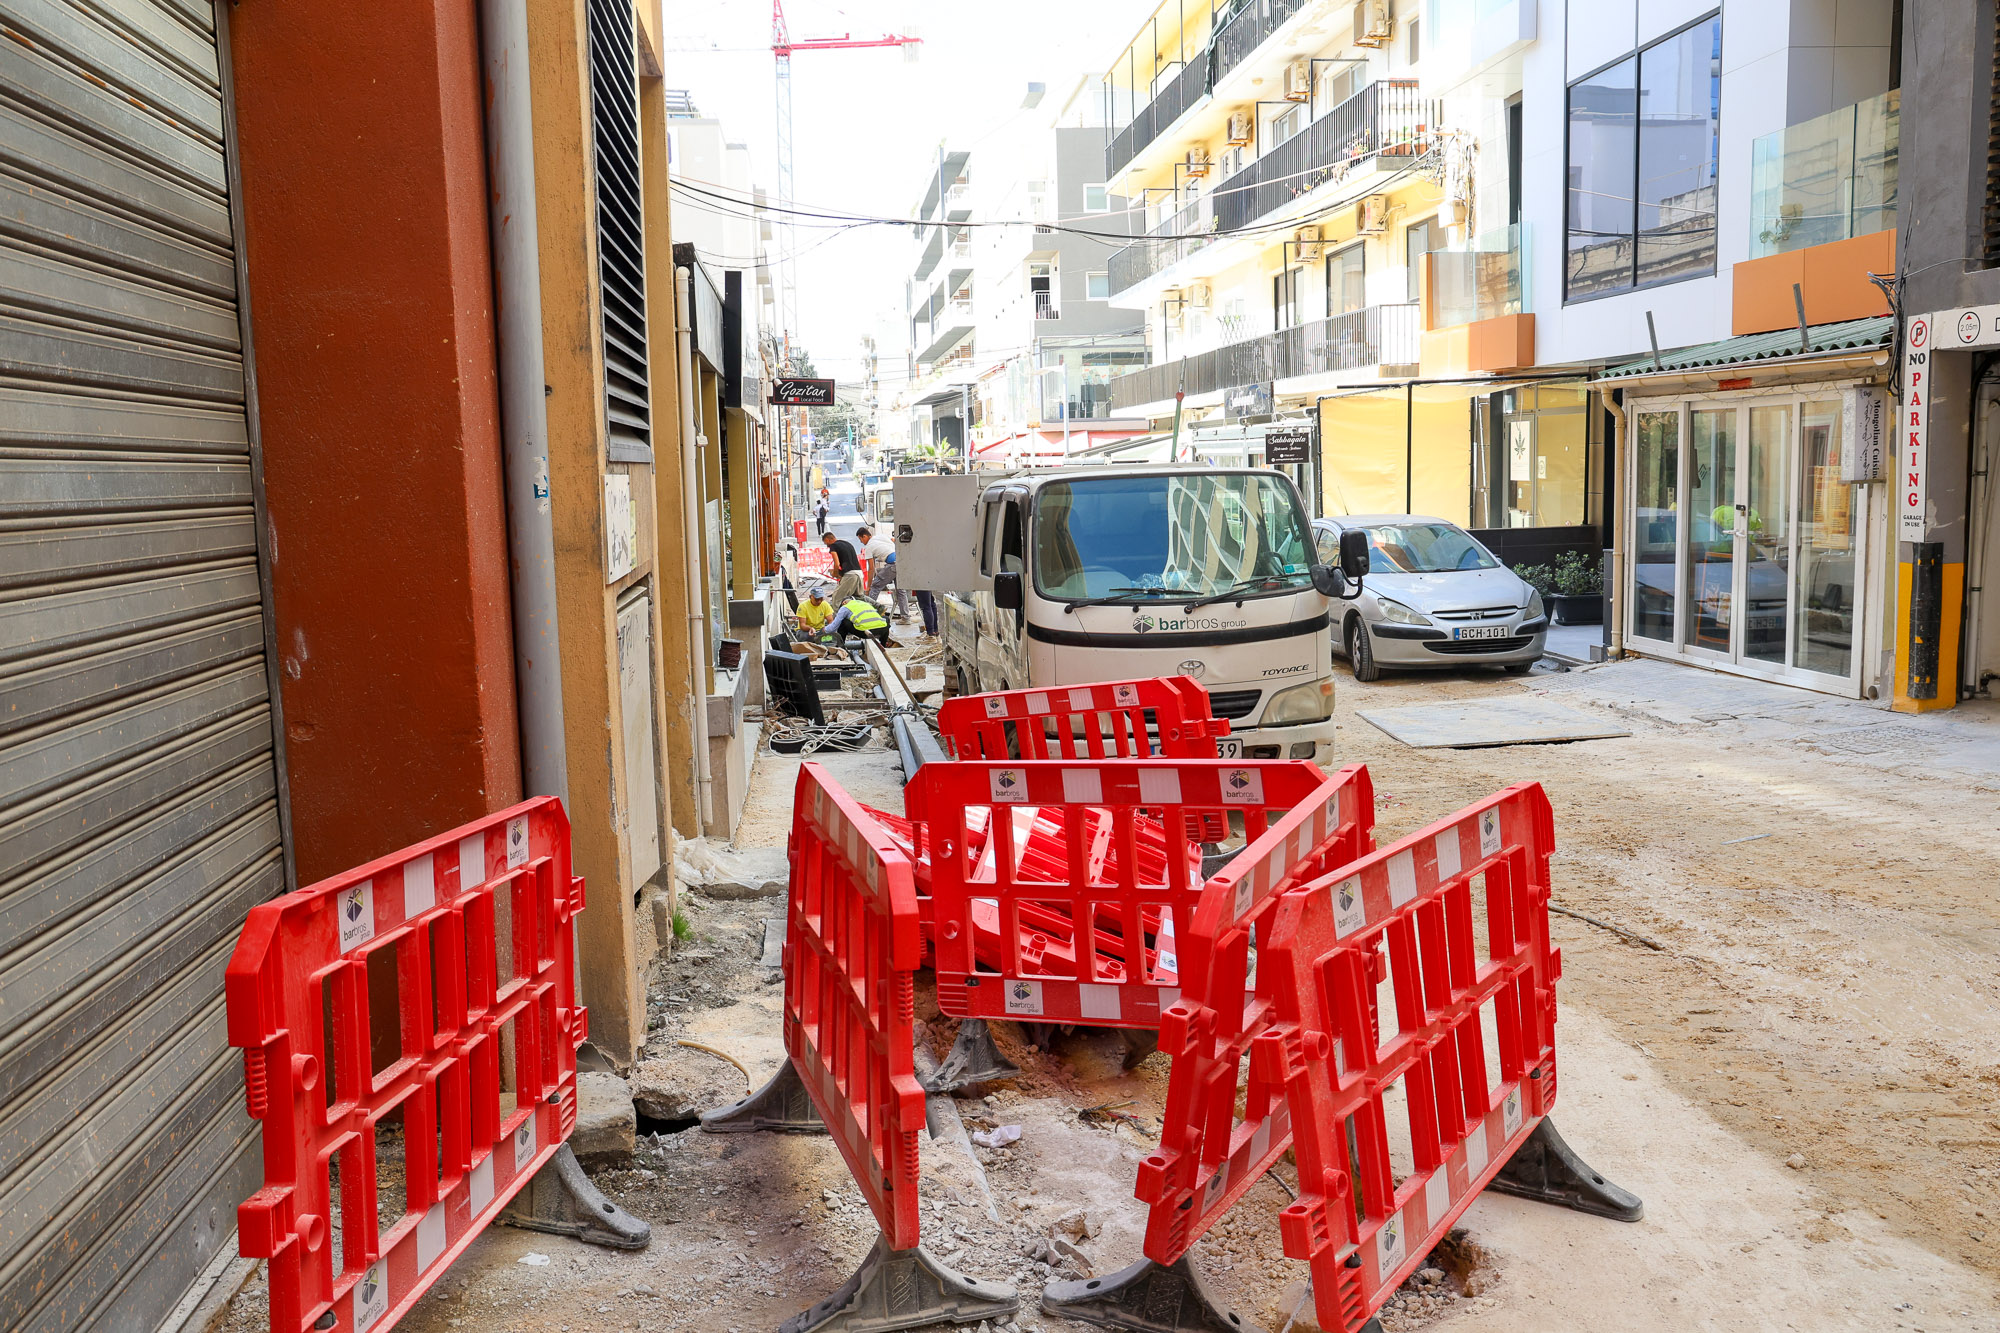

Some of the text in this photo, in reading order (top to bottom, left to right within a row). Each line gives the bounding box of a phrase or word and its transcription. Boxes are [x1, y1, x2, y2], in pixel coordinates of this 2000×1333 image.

[1960, 324, 1978, 332] 2.05m
[1909, 353, 1926, 366] NO
[779, 381, 827, 400] Gozitan
[1872, 399, 1881, 446] Mongolian
[1908, 372, 1921, 507] PARKING
[1159, 617, 1247, 631] barbros group
[1486, 627, 1506, 638] 101
[1262, 664, 1310, 677] TOYOACE
[1226, 790, 1255, 798] barbros
[343, 922, 367, 941] barbros
[360, 930, 371, 941] group
[1009, 1001, 1035, 1009] barbros
[358, 1299, 381, 1328] barbros
